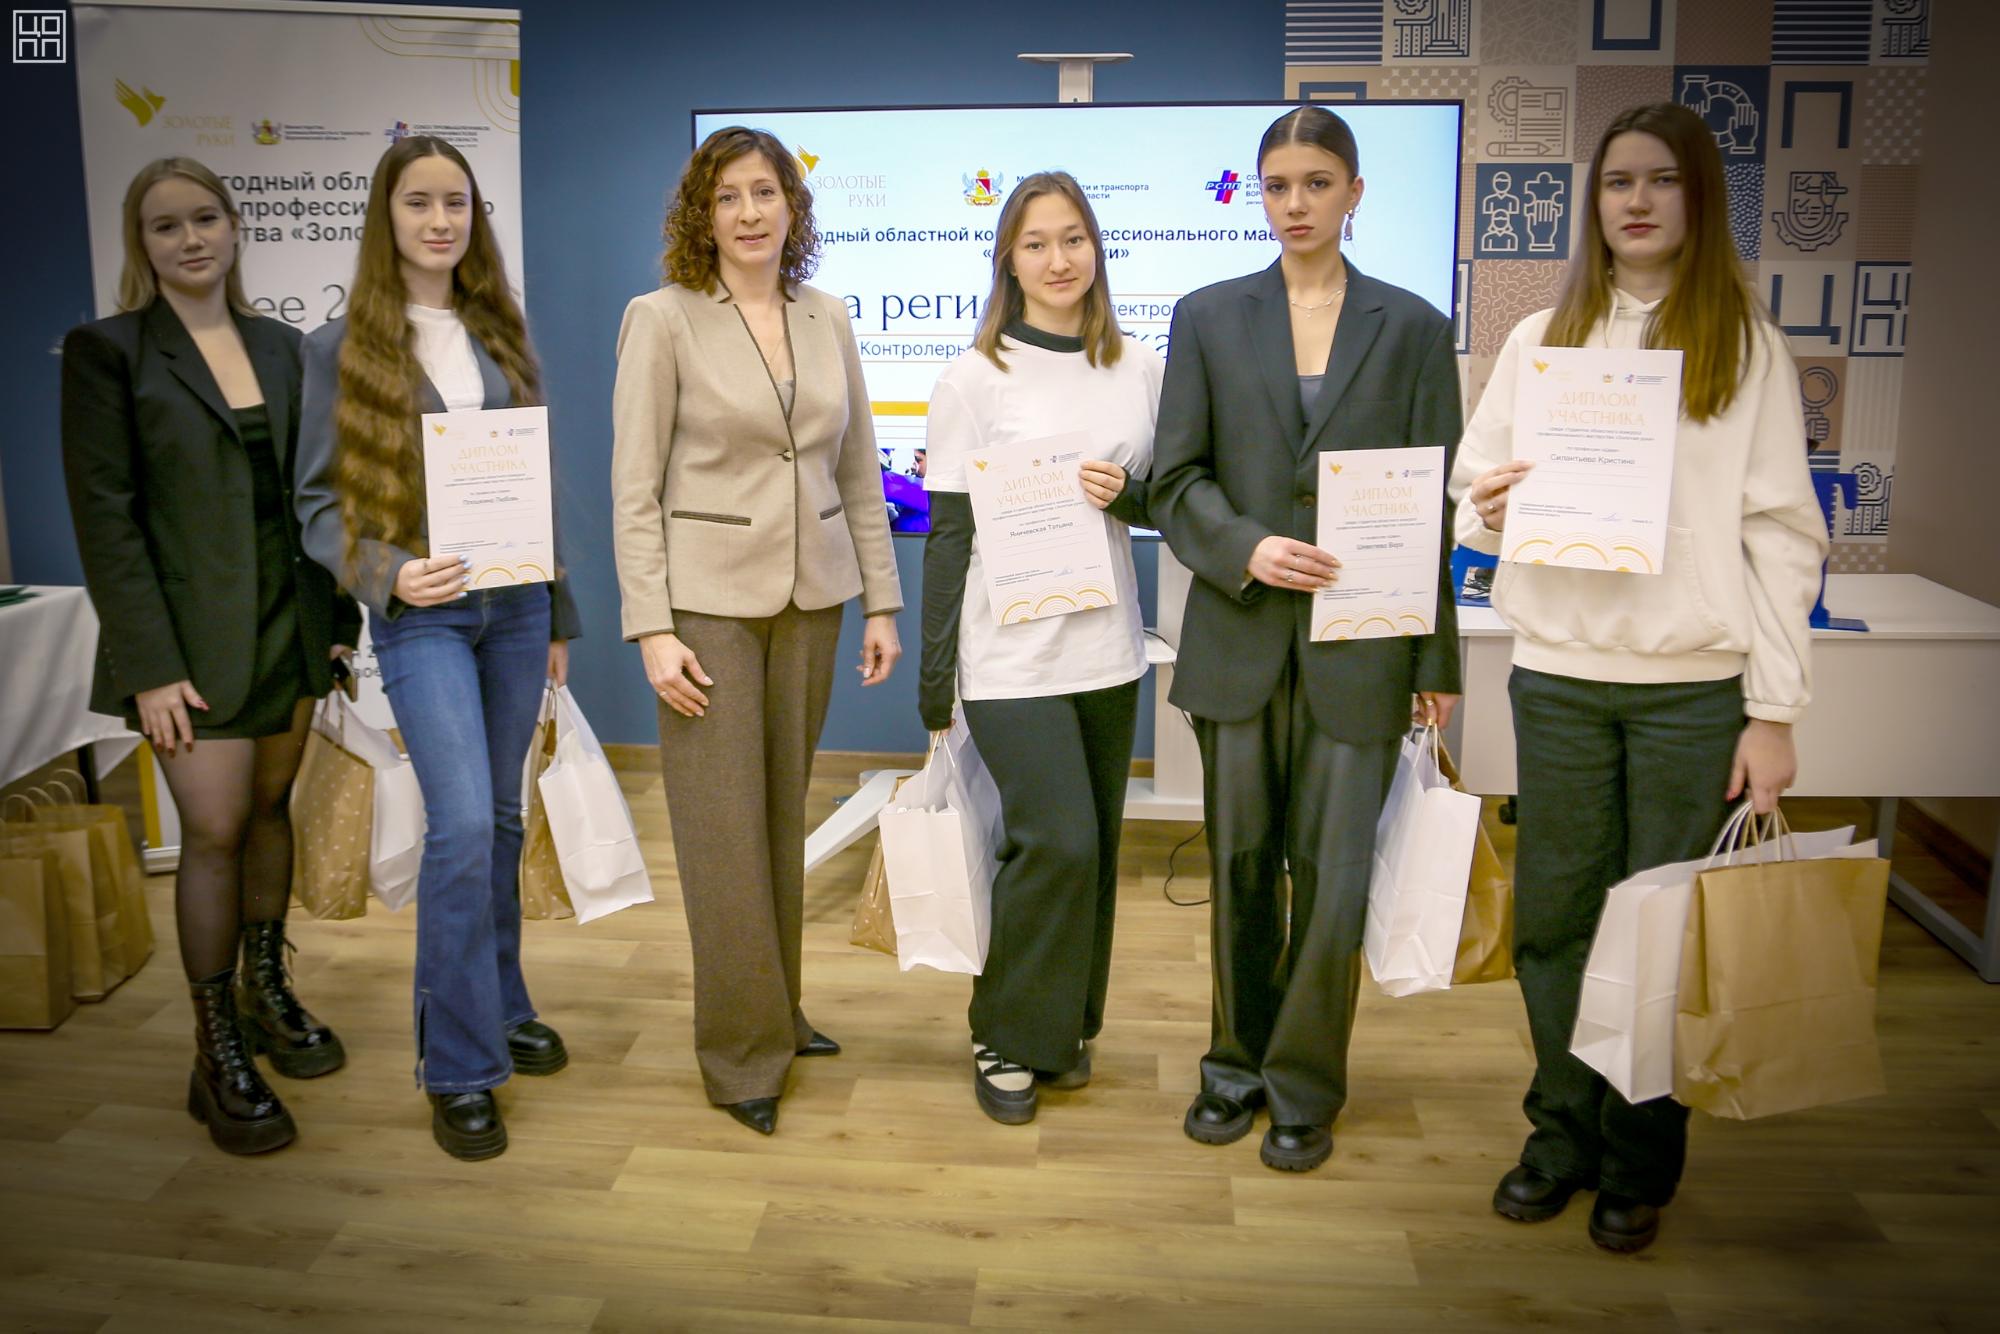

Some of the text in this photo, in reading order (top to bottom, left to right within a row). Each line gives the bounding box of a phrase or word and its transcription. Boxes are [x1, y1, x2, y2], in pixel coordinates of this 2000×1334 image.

[815, 175, 887, 189] ЗОЛОТЫЕ
[1206, 182, 1241, 190] РСПП
[849, 194, 886, 207] РУКИ
[875, 226, 969, 241] областной
[1558, 391, 1637, 408] ДИПЛОМ
[1548, 409, 1646, 427] УЧАСТНИКА
[458, 444, 519, 459] ДИПЛОМ
[451, 459, 528, 475] УЧАСТНИКА
[1003, 470, 1065, 493] ДИПЛОМ
[996, 484, 1074, 506] УЧАСТНИКА
[1352, 486, 1414, 501] ДИПЛОМ
[1344, 502, 1420, 517] УЧАСТНИКА
